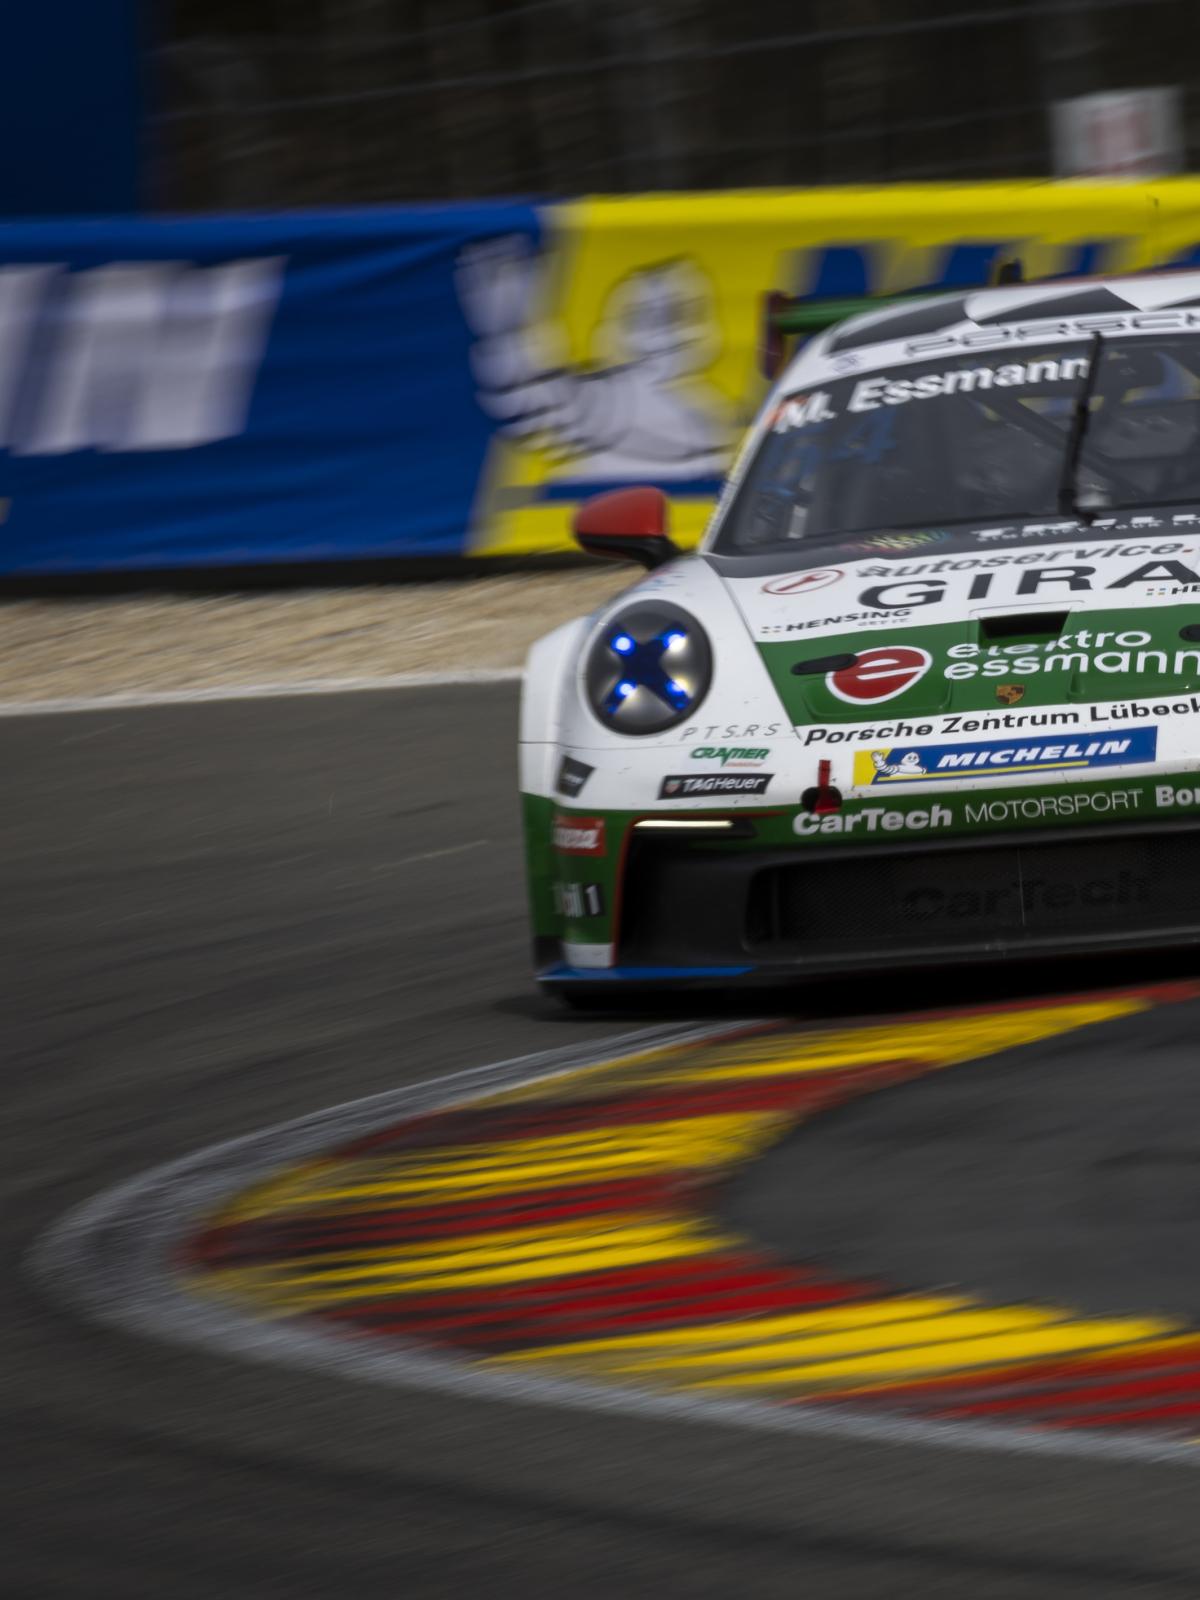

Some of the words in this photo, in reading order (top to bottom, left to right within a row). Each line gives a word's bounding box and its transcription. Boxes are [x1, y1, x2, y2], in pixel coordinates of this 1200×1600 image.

[847, 355, 1091, 414] Essmann
[785, 607, 913, 632] HENSING
[946, 628, 1153, 659] elektro
[803, 722, 934, 747] Porsche
[940, 709, 1080, 735] Zentrum
[690, 747, 771, 768] CRAMER
[936, 738, 1133, 768] MICHELIN
[792, 803, 953, 836] CarTech
[965, 788, 1144, 823] MOTORSPORT
[903, 870, 1151, 921] CarTech
